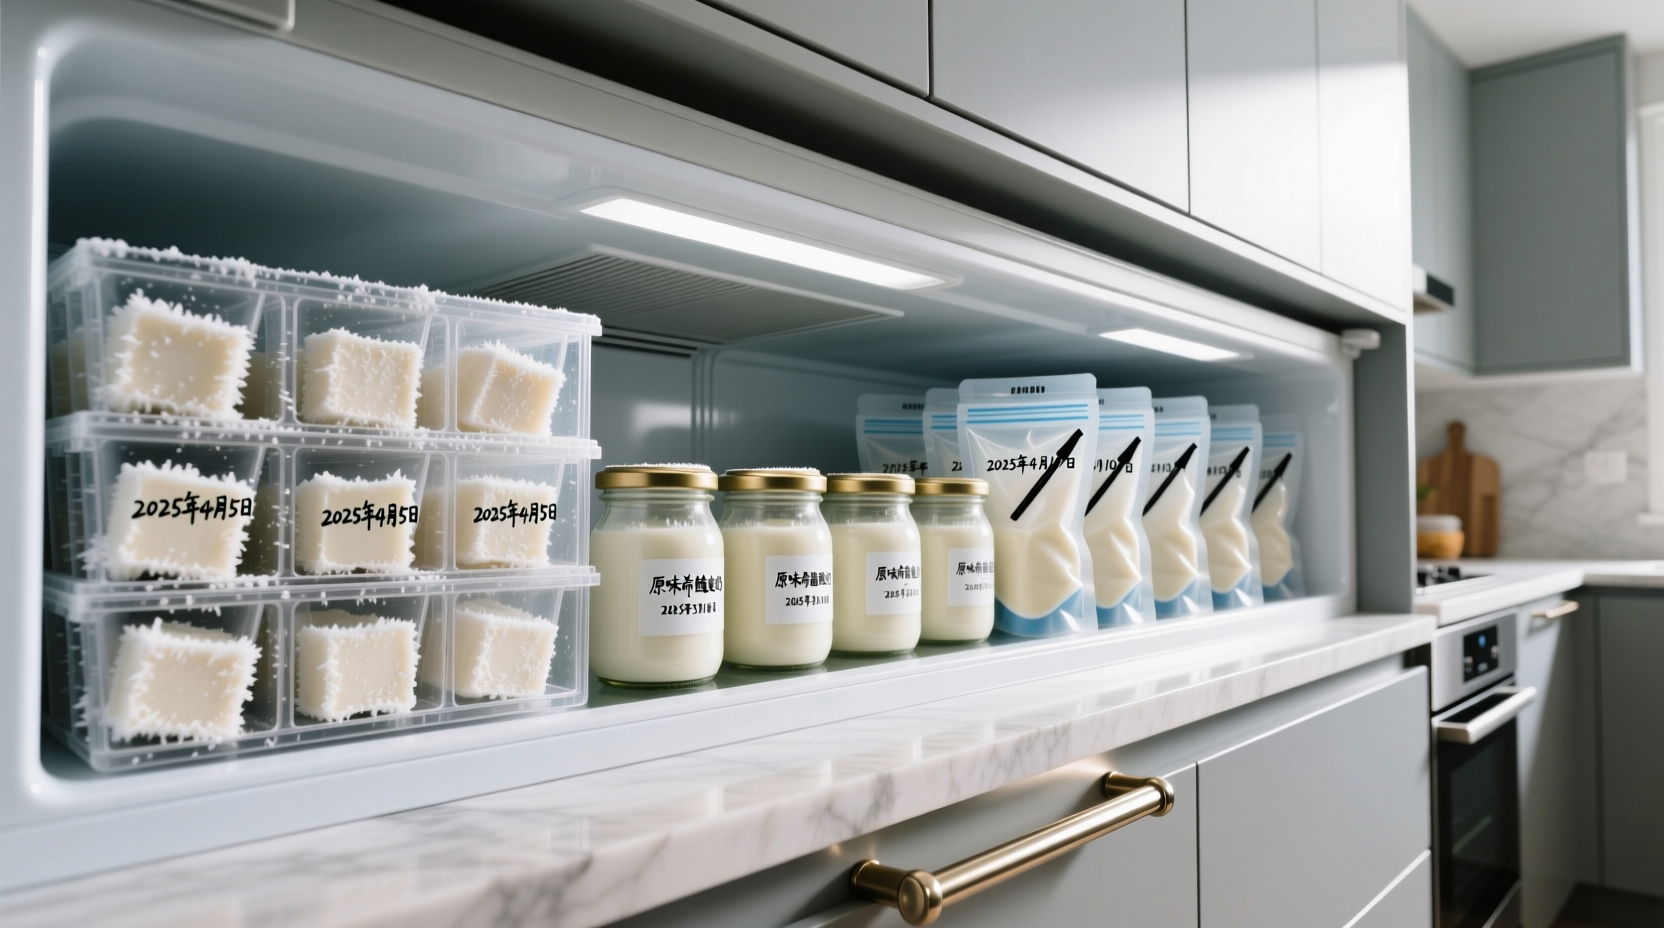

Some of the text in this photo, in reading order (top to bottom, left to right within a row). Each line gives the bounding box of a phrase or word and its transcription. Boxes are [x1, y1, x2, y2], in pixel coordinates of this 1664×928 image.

[132, 491, 253, 525] 2025年4月5日
[321, 500, 418, 530] 2025年4月5日
[474, 500, 558, 527] 2025年4月5日
